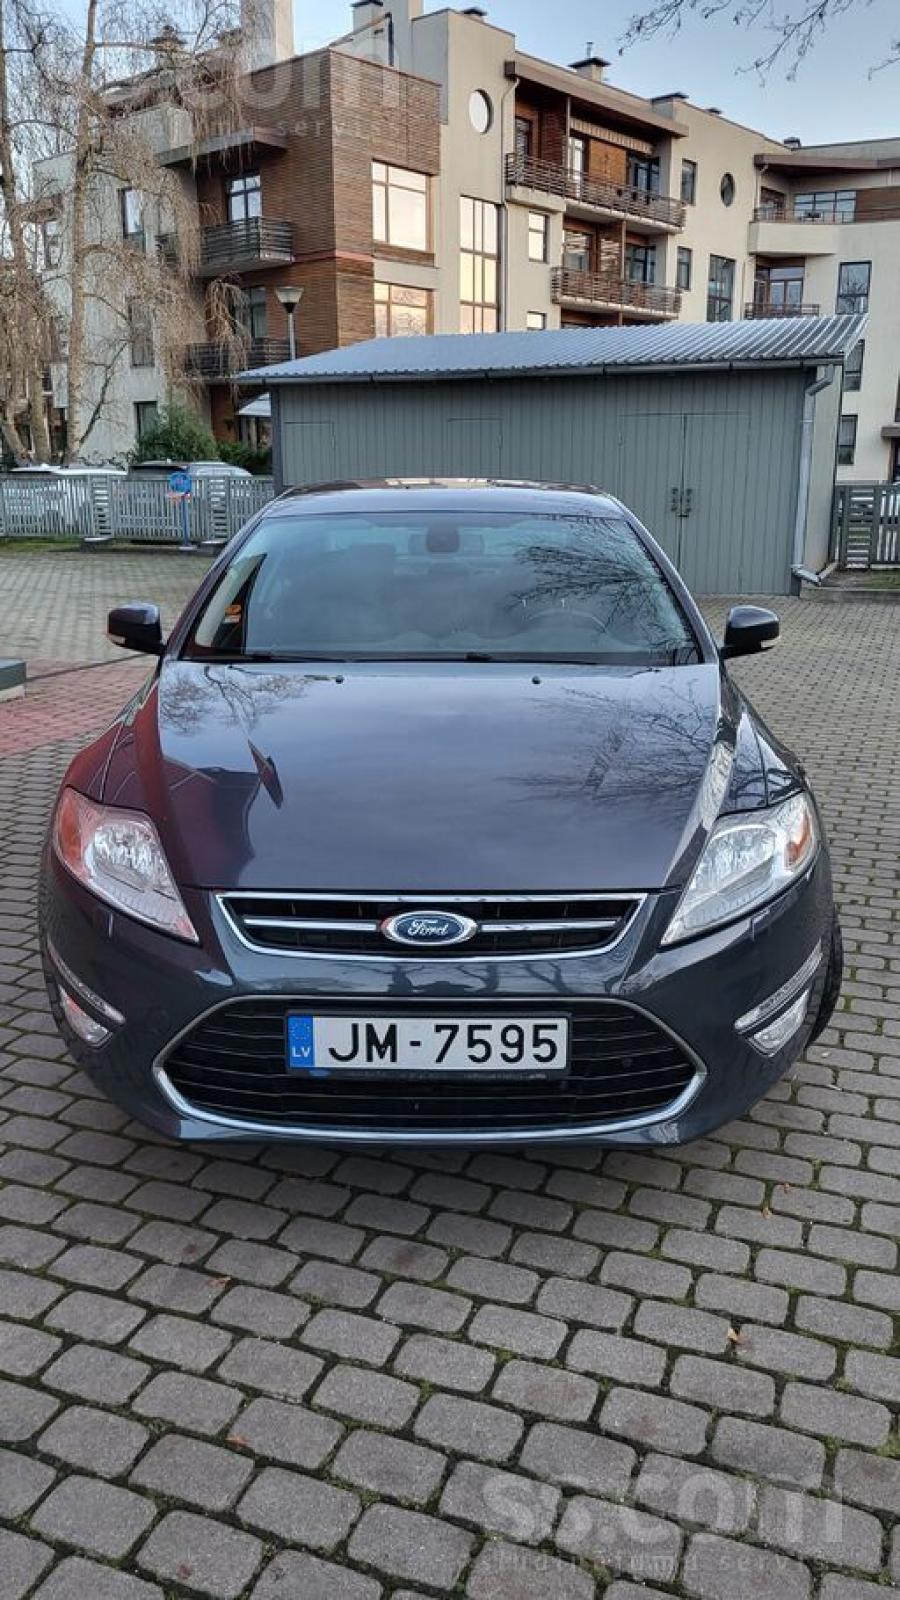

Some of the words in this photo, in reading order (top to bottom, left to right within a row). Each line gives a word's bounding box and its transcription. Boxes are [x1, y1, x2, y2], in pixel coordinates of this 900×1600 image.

[407, 919, 449, 936] Ford
[292, 1046, 310, 1057] LV
[328, 1023, 559, 1063] JM-7595
